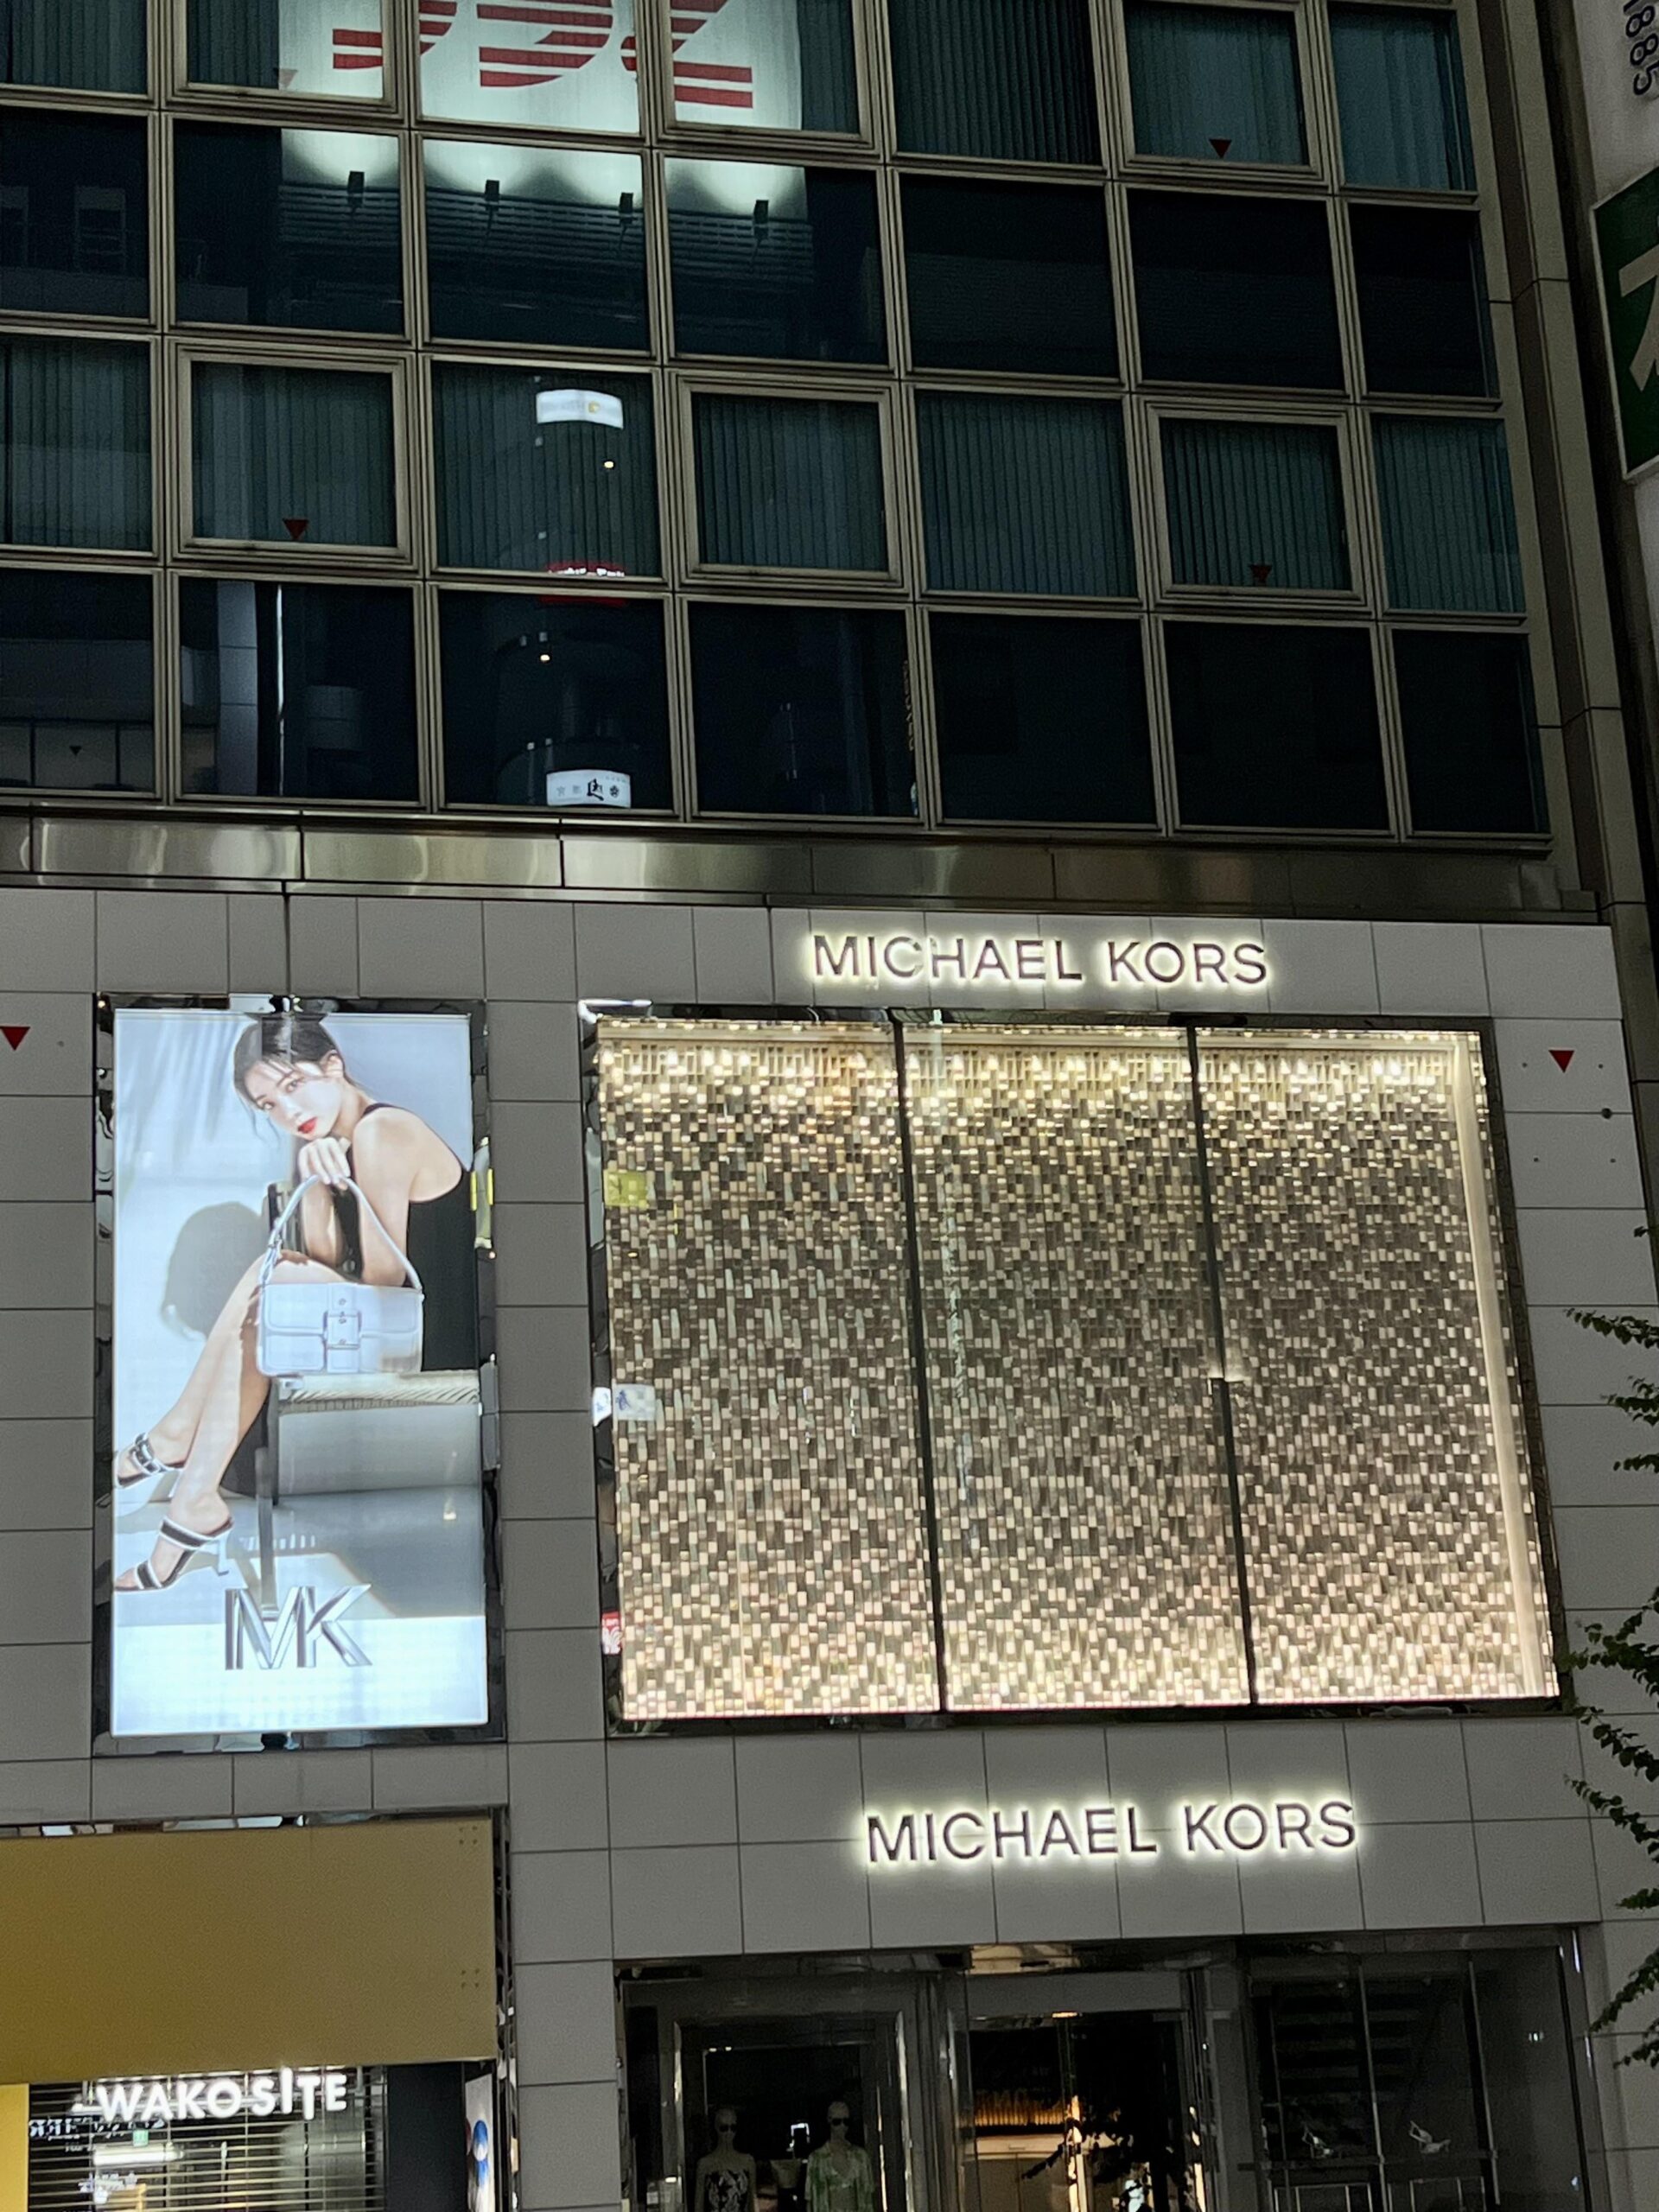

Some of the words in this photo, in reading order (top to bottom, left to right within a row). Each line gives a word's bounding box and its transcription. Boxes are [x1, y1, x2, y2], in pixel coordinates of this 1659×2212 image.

[813, 935, 1083, 982] MICHAEL
[1108, 941, 1268, 984] KORS
[225, 1583, 373, 1671] MK
[867, 1806, 1158, 1862] MICHAEL
[1183, 1800, 1357, 1852] KORS
